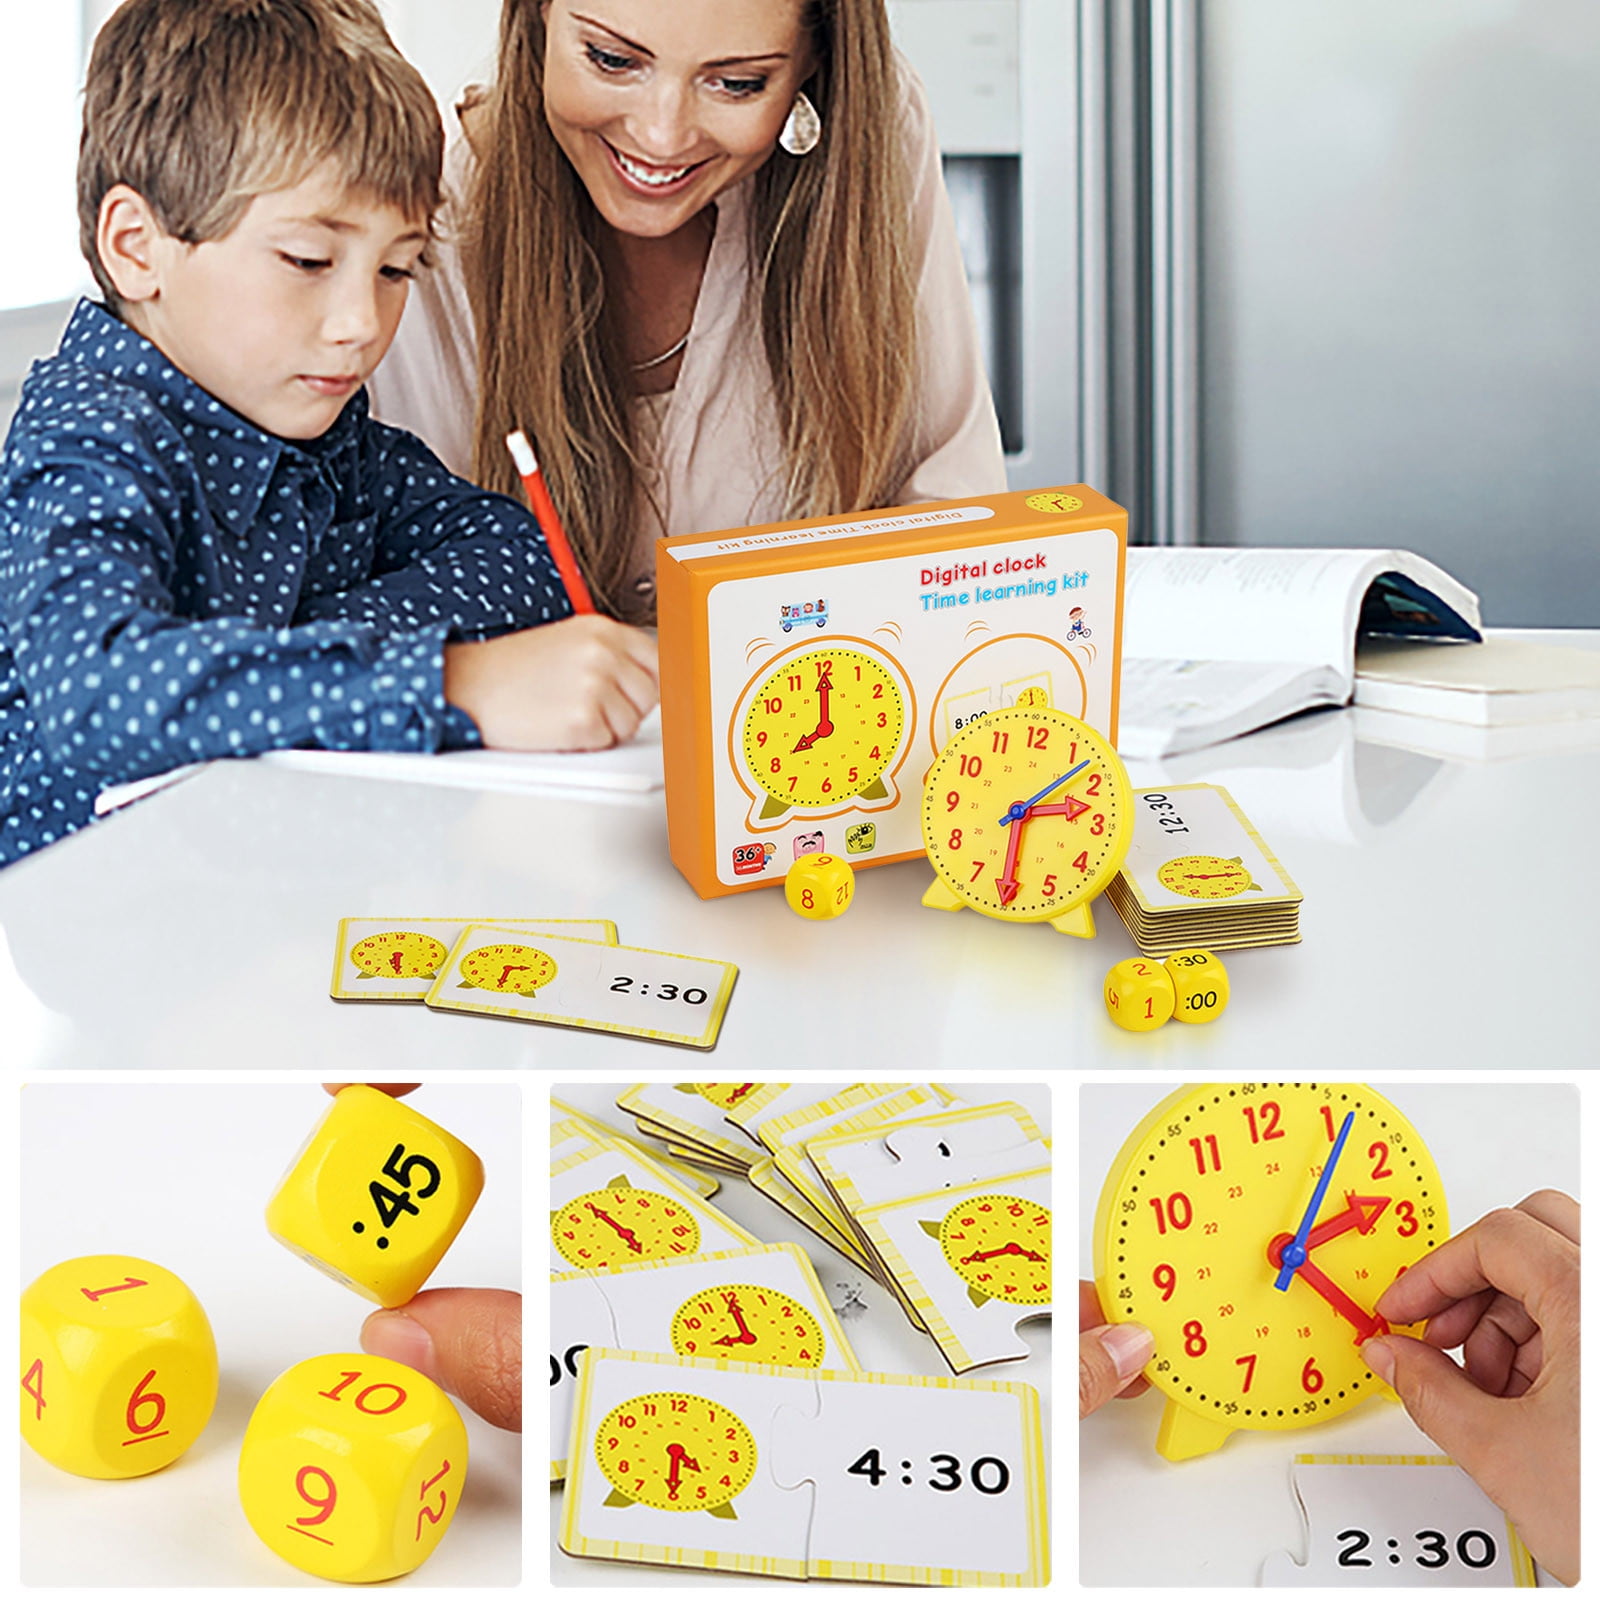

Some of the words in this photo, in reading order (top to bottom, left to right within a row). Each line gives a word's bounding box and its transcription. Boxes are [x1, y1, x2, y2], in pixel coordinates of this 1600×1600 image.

[920, 560, 987, 585] Digital
[993, 553, 1047, 574] clock
[920, 592, 969, 611] Time
[975, 577, 1057, 604] learning
[1063, 571, 1089, 589] kit
[815, 660, 833, 677] 12
[855, 666, 860, 681] 1
[788, 675, 801, 691] 11
[873, 684, 883, 699] 2
[764, 698, 782, 714] 10
[877, 712, 887, 728] 3
[955, 711, 987, 729] 8:0
[757, 732, 767, 747] 9
[993, 731, 1008, 754] 11
[1027, 726, 1049, 750] 12
[869, 746, 881, 760] 4
[1070, 742, 1077, 764] 1
[771, 758, 781, 773] 8
[960, 754, 982, 778] 10
[848, 767, 858, 782] 5
[788, 776, 798, 792] 7
[822, 778, 832, 793] 6
[1086, 774, 1101, 796] 2
[947, 791, 959, 812] 9
[1143, 793, 1190, 835] 12:30
[1090, 814, 1104, 835] 3
[949, 829, 962, 850] 8
[1072, 851, 1088, 873] 4
[970, 861, 985, 882] 7
[1042, 875, 1057, 896] 5
[802, 889, 814, 909] 8
[837, 882, 848, 905] 12
[1173, 954, 1208, 967] :30
[1133, 964, 1152, 976] 2
[610, 976, 708, 1005] 2:30
[1109, 988, 1118, 1009] 5
[1185, 991, 1217, 1011] :00
[1145, 997, 1153, 1018] 1
[1242, 1083, 1256, 1095] 60
[1324, 1088, 1331, 1099] 5
[1242, 1101, 1286, 1144] 12
[1319, 1104, 1334, 1142] 1
[1168, 1124, 1181, 1137] 55
[1389, 1133, 1402, 1144] 10
[1189, 1134, 1222, 1175] 11
[1369, 1142, 1392, 1180] 2
[1266, 1163, 1280, 1175] 24
[352, 1143, 441, 1250] :45
[1228, 1186, 1243, 1198] 23
[637, 1199, 650, 1208] 8
[1007, 1203, 1024, 1217] 10
[1122, 1200, 1136, 1213] 50
[569, 1214, 581, 1224] 5
[1150, 1192, 1193, 1234] 10
[1395, 1200, 1418, 1237] 3
[1422, 1206, 1435, 1217] 15
[961, 1218, 975, 1226] 8
[1033, 1215, 1048, 1226] 11
[672, 1225, 691, 1237] 10
[1204, 1222, 1218, 1235] 22
[578, 1249, 591, 1258] 3
[669, 1242, 686, 1253] 11
[977, 1274, 992, 1282] 5
[1197, 1267, 1210, 1279] 21
[1356, 1269, 1368, 1279] 16
[81, 1278, 148, 1301] 1
[1153, 1264, 1176, 1301] 9
[719, 1291, 739, 1304] 12
[1119, 1287, 1132, 1298] 45
[698, 1302, 714, 1314] 11
[758, 1295, 767, 1306] 1
[781, 1306, 793, 1317] 2
[1219, 1304, 1234, 1317] 20
[683, 1318, 701, 1330] 10
[794, 1325, 806, 1337] 3
[1183, 1320, 1207, 1357] 8
[1256, 1326, 1269, 1338] 19
[1297, 1327, 1311, 1338] 18
[685, 1341, 696, 1353] 9
[800, 1349, 811, 1360] 4
[1157, 1360, 1170, 1371] 40
[1236, 1355, 1256, 1393] 7
[1302, 1357, 1324, 1394] 6
[21, 1359, 46, 1420] 4
[318, 1371, 408, 1416] 10
[126, 1369, 166, 1437] 6
[644, 1404, 656, 1416] 11
[671, 1400, 687, 1413] 12
[1224, 1402, 1238, 1415] 35
[1304, 1401, 1317, 1413] 30
[618, 1415, 636, 1428] 10
[709, 1410, 715, 1422] 1
[726, 1428, 736, 1440] 2
[608, 1438, 619, 1450] 9
[729, 1450, 739, 1463] 3
[618, 1460, 629, 1473] 8
[847, 1448, 1011, 1495] 4:30
[635, 1479, 644, 1491] 7
[719, 1475, 731, 1487] 4
[295, 1465, 338, 1527] 9
[696, 1486, 706, 1499] 5
[415, 1459, 452, 1542] 12
[1337, 1529, 1497, 1568] 2:30
